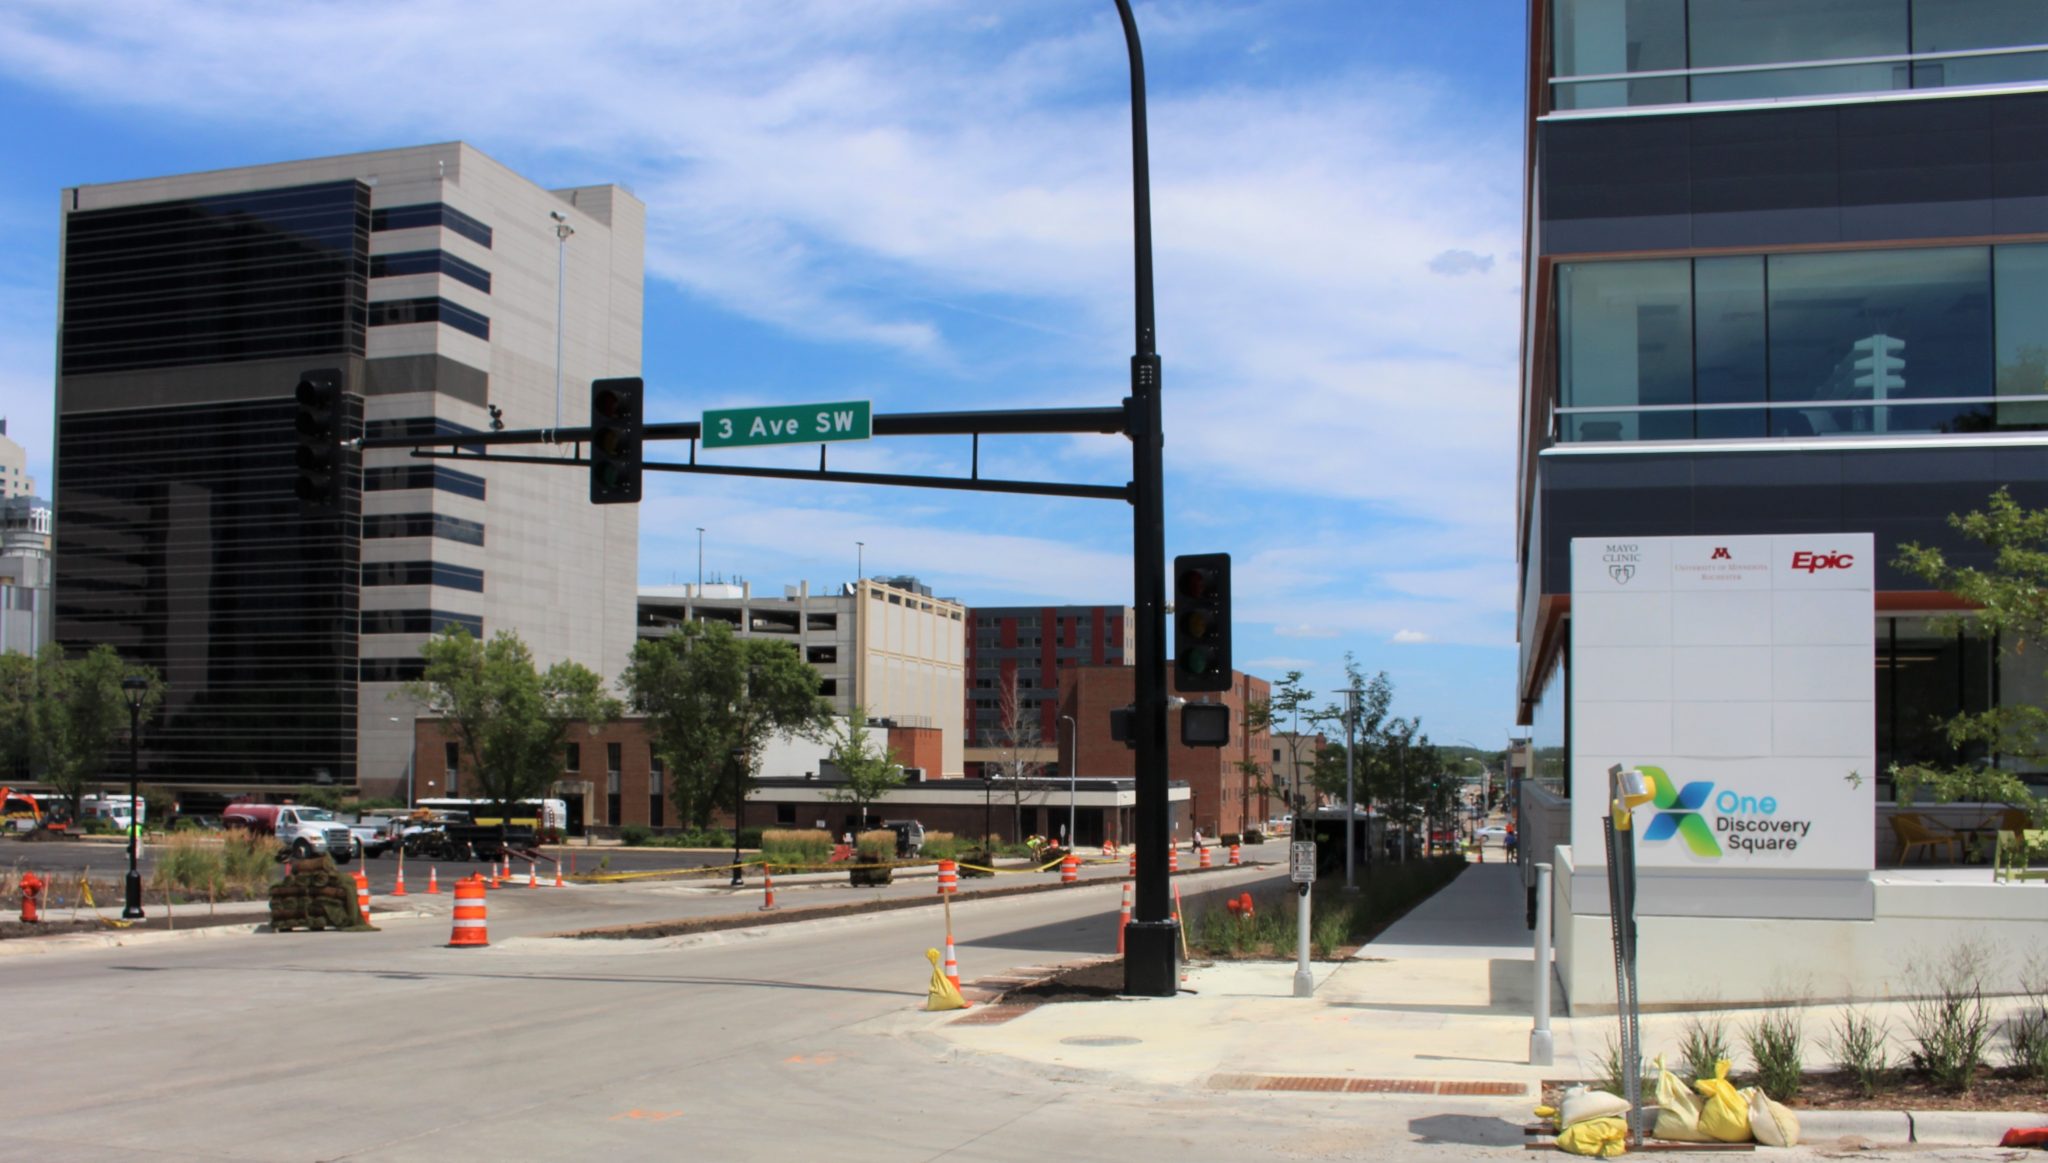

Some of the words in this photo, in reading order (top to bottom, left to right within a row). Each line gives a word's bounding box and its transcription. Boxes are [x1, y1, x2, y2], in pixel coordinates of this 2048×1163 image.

[718, 418, 733, 439] 3
[750, 416, 799, 437] Ave
[815, 410, 854, 433] SW
[1602, 554, 1641, 562] CLINIC
[1606, 544, 1638, 552] MAYO
[1791, 550, 1854, 573] Epic
[1716, 790, 1777, 815] One
[1716, 816, 1811, 837] Discovery
[1728, 834, 1798, 854] Square
